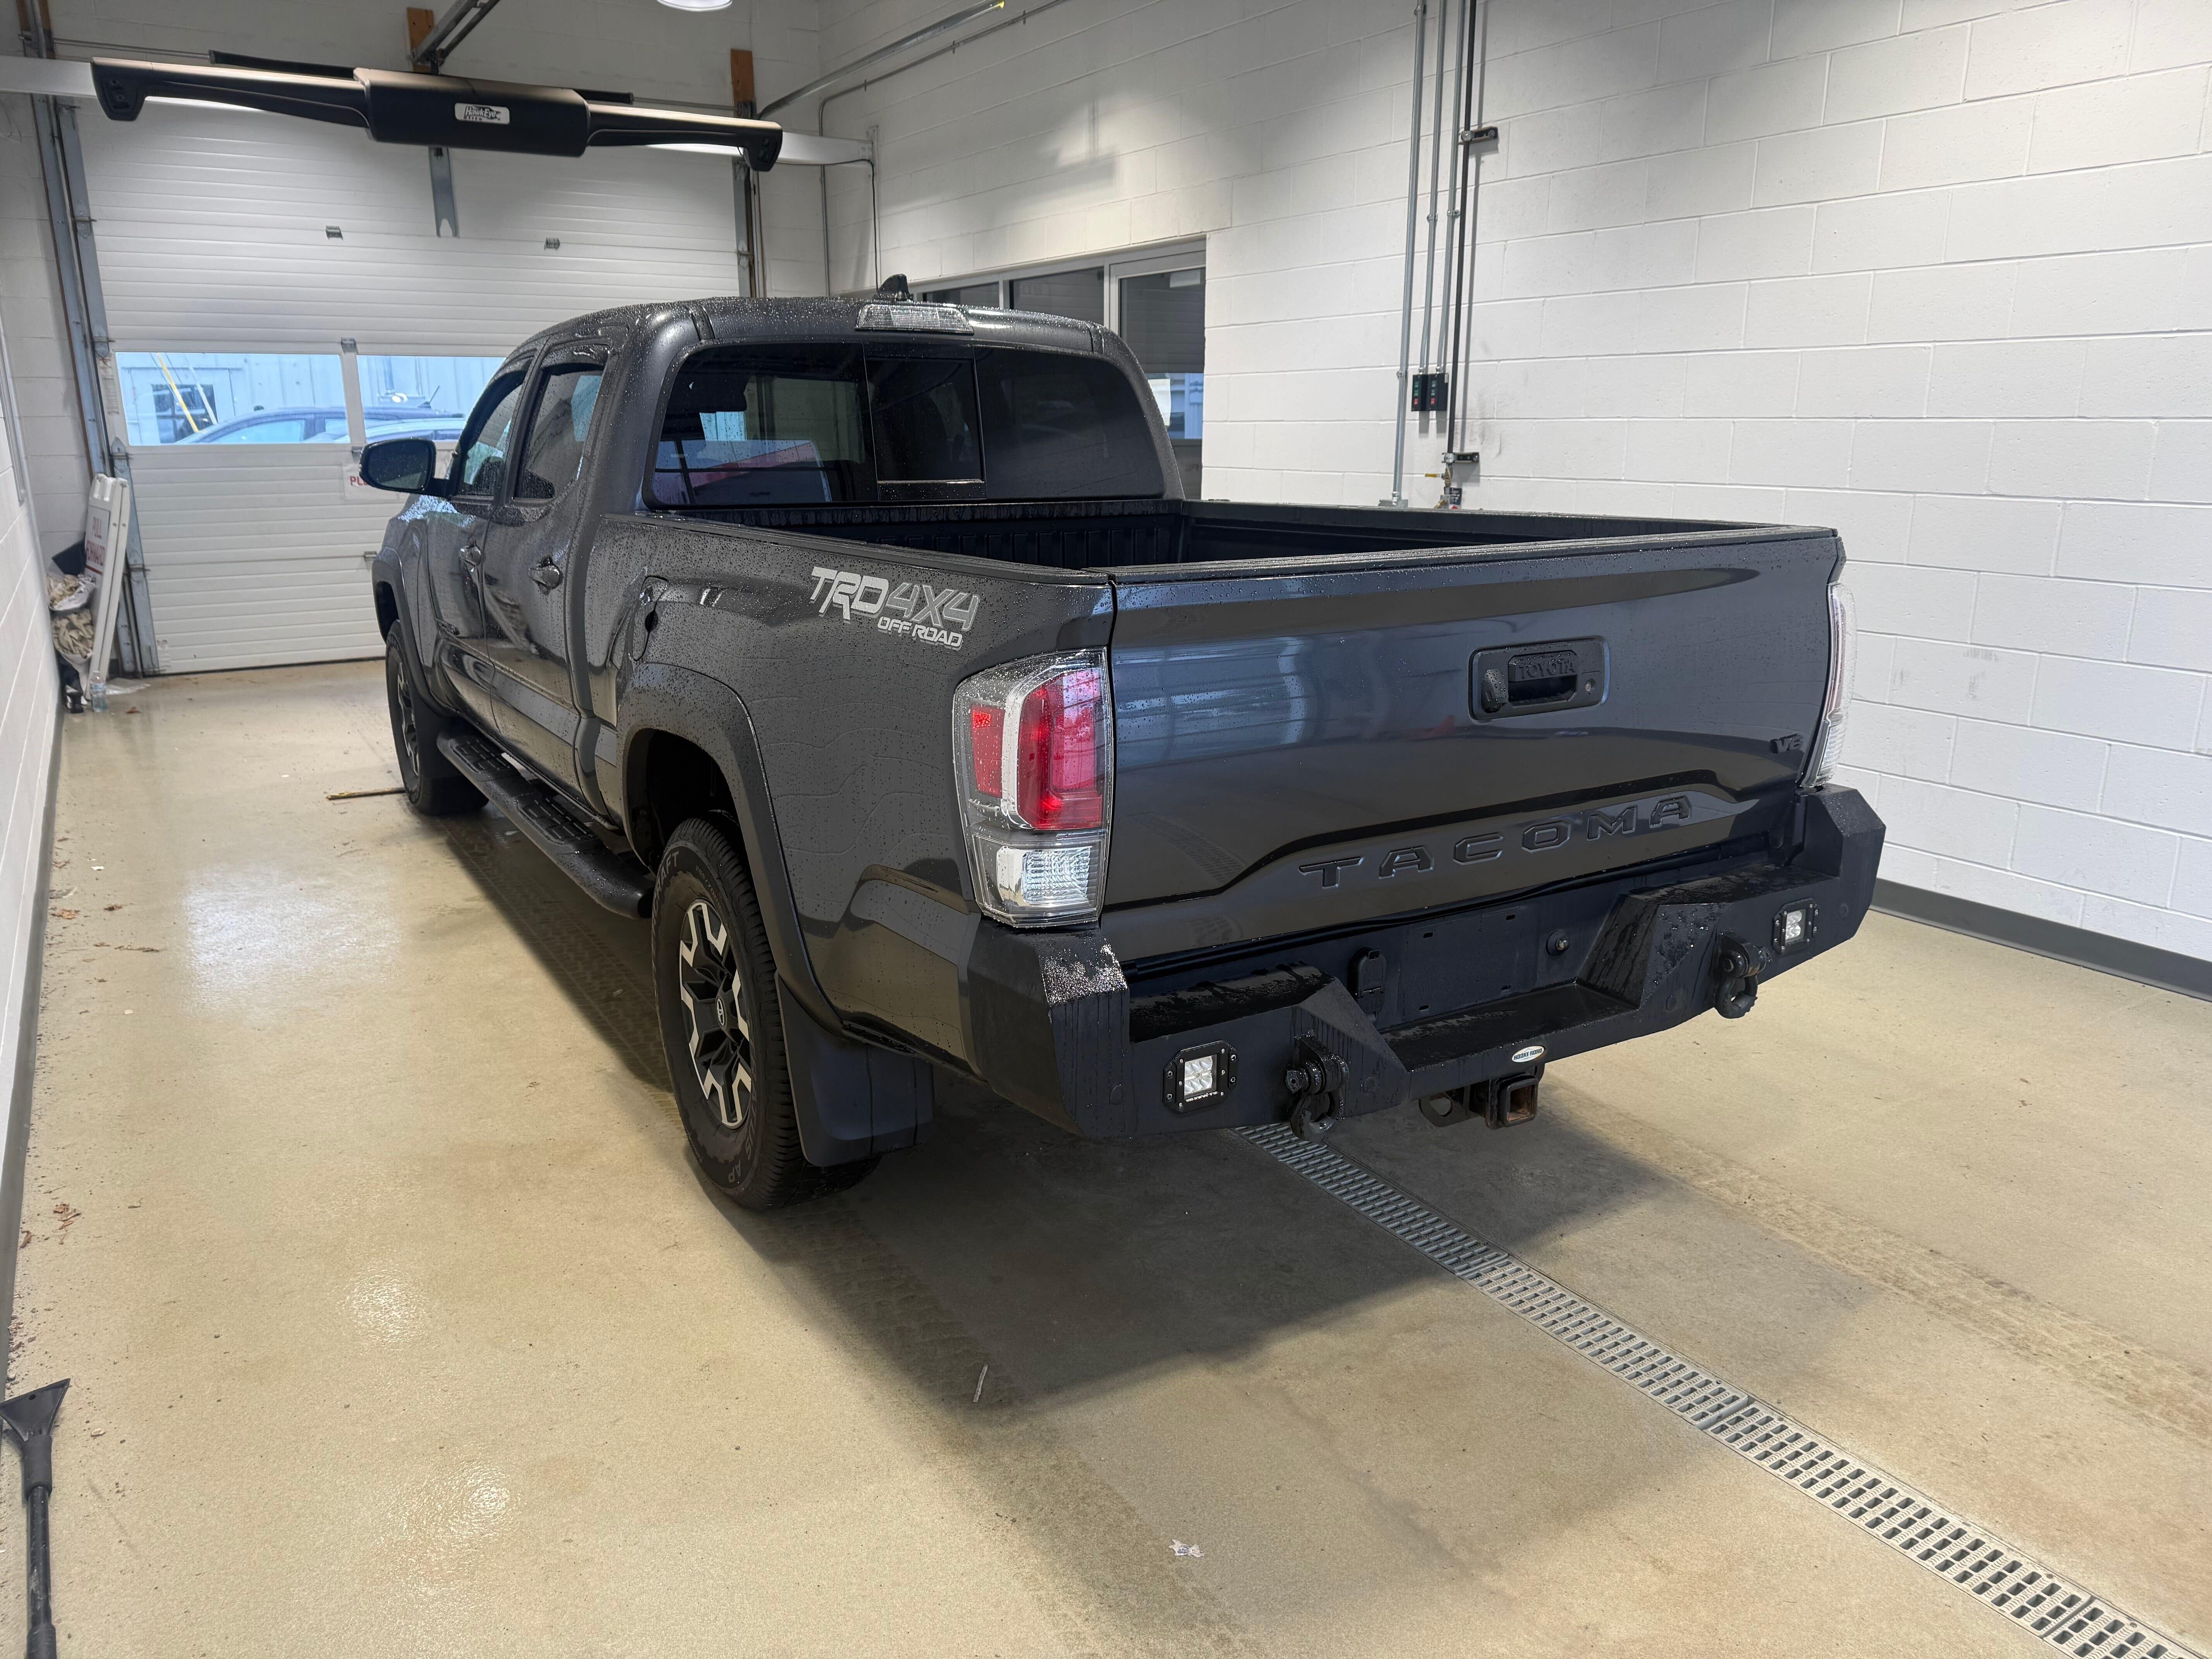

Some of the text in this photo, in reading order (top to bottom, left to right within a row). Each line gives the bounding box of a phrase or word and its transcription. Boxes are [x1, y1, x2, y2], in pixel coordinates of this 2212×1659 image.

[465, 106, 496, 118] HawkEye
[810, 566, 890, 623] TRD
[877, 617, 963, 650] OFF ROAD
[1518, 659, 1578, 680] TOYOTA
[1771, 734, 1803, 754] V6
[1298, 794, 1692, 889] TACOMA
[1513, 1052, 1529, 1060] HOOKE
[727, 1158, 741, 1183] AP
